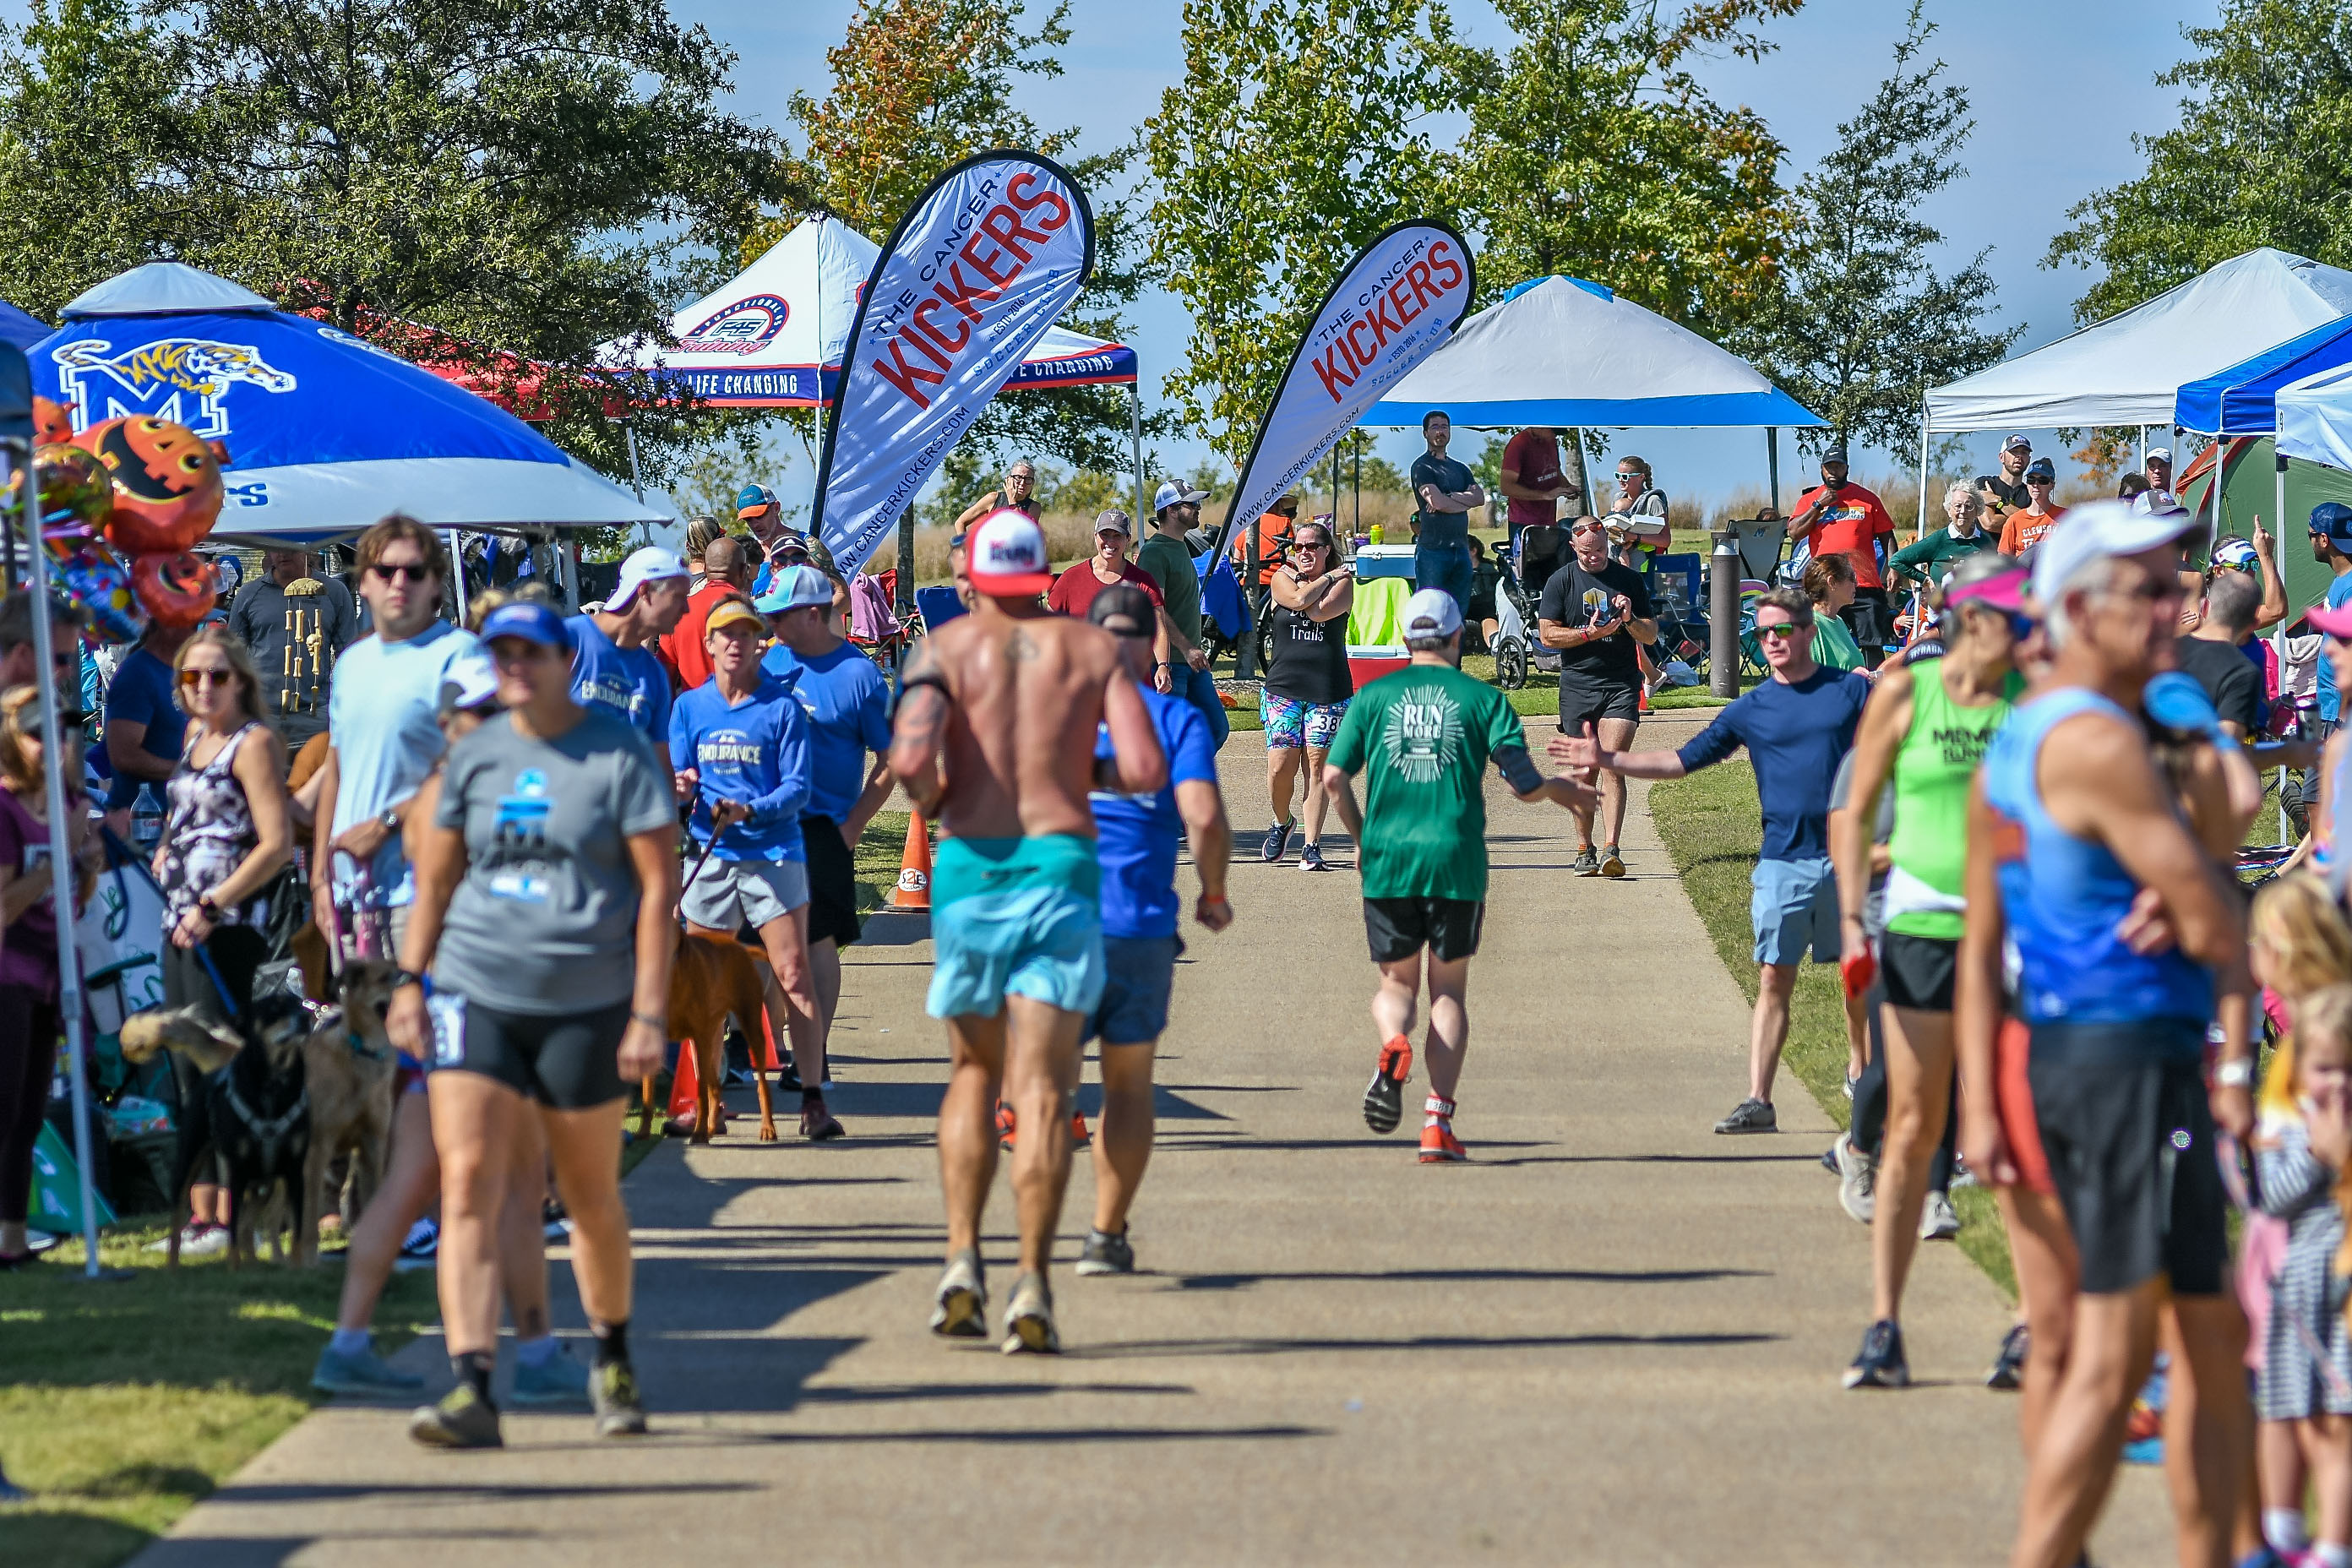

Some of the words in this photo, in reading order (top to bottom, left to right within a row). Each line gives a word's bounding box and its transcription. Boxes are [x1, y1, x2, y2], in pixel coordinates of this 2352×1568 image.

[872, 288, 918, 335] THE
[919, 177, 999, 282] CANCER
[872, 172, 1071, 411] KICKERS
[1318, 308, 1355, 341] THE
[1358, 239, 1425, 307] CANCER
[973, 323, 1034, 377] SOCCER
[1034, 269, 1060, 318] CLUB
[993, 316, 1012, 336] ESTD
[1008, 298, 1026, 317] 2016
[1310, 240, 1463, 405] KICKERS
[1035, 355, 1113, 377] CHANGING
[1391, 345, 1406, 360] ESTD
[1403, 334, 1417, 348] 2016
[724, 374, 798, 395] CHANGING
[1236, 406, 1360, 527] WWW.CANCERKICKERS.COM
[837, 406, 971, 576] W.CANCERKICKERS.COM
[1289, 624, 1324, 642] Trails
[1403, 704, 1444, 726] RUN
[1403, 725, 1442, 739] MORE
[697, 743, 762, 765] ENDURANCE
